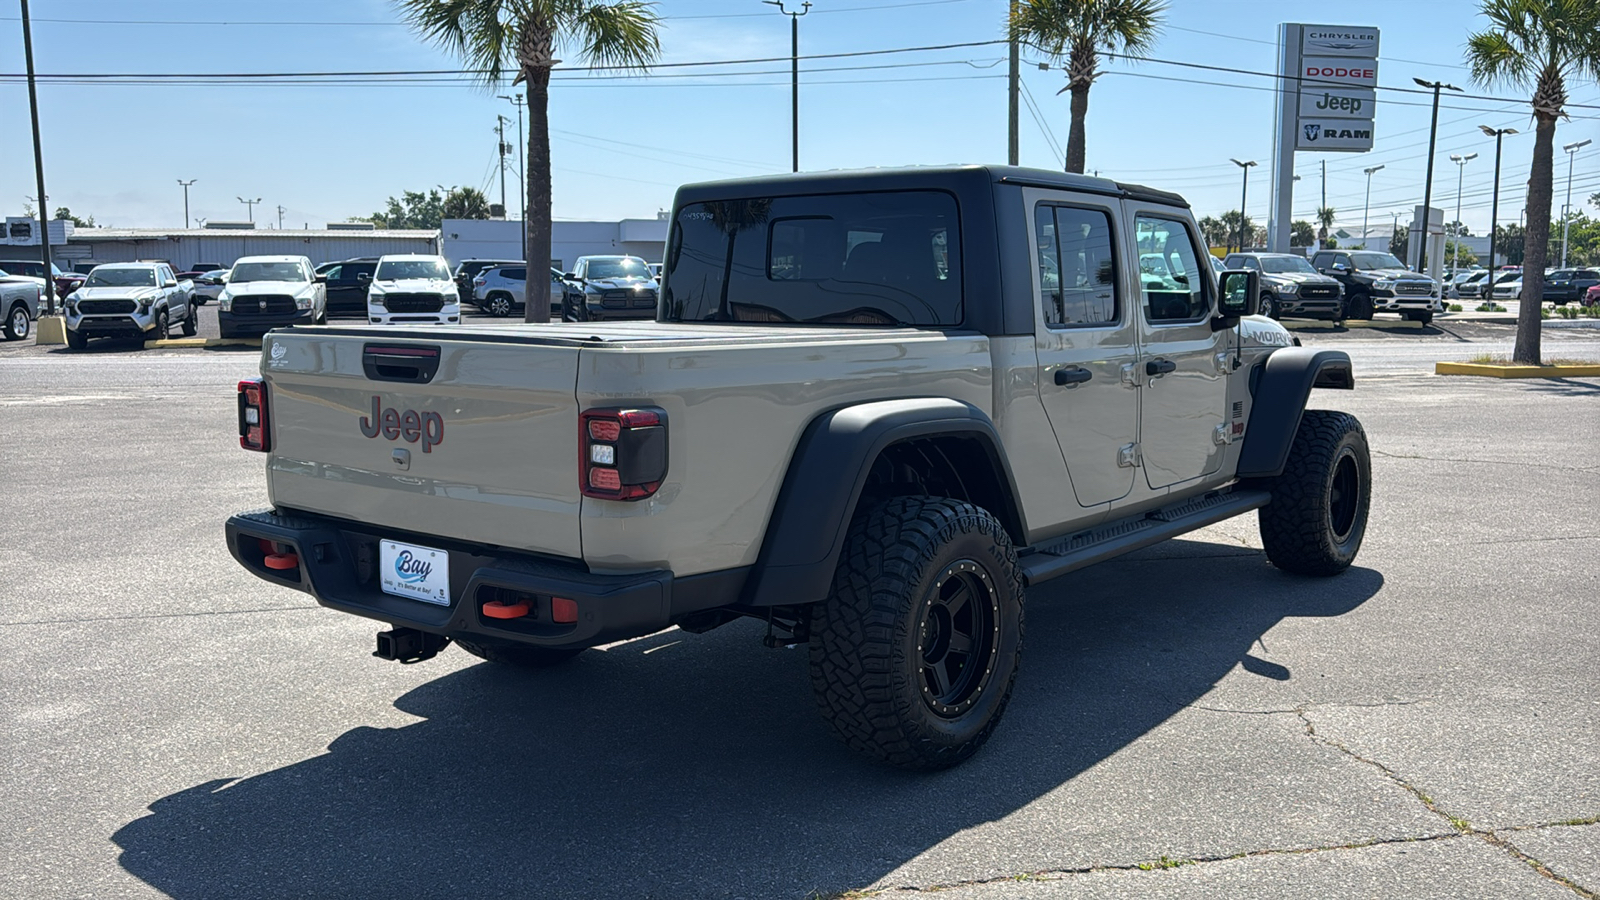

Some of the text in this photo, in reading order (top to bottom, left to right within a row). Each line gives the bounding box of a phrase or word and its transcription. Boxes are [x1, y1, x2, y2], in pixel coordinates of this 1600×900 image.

[1309, 32, 1374, 41] CHRYSLER
[1306, 67, 1374, 79] DODGE
[1316, 92, 1362, 114] Jeep
[1323, 128, 1370, 139] RAM
[359, 395, 445, 454] Jeep
[398, 550, 433, 583] Bay
